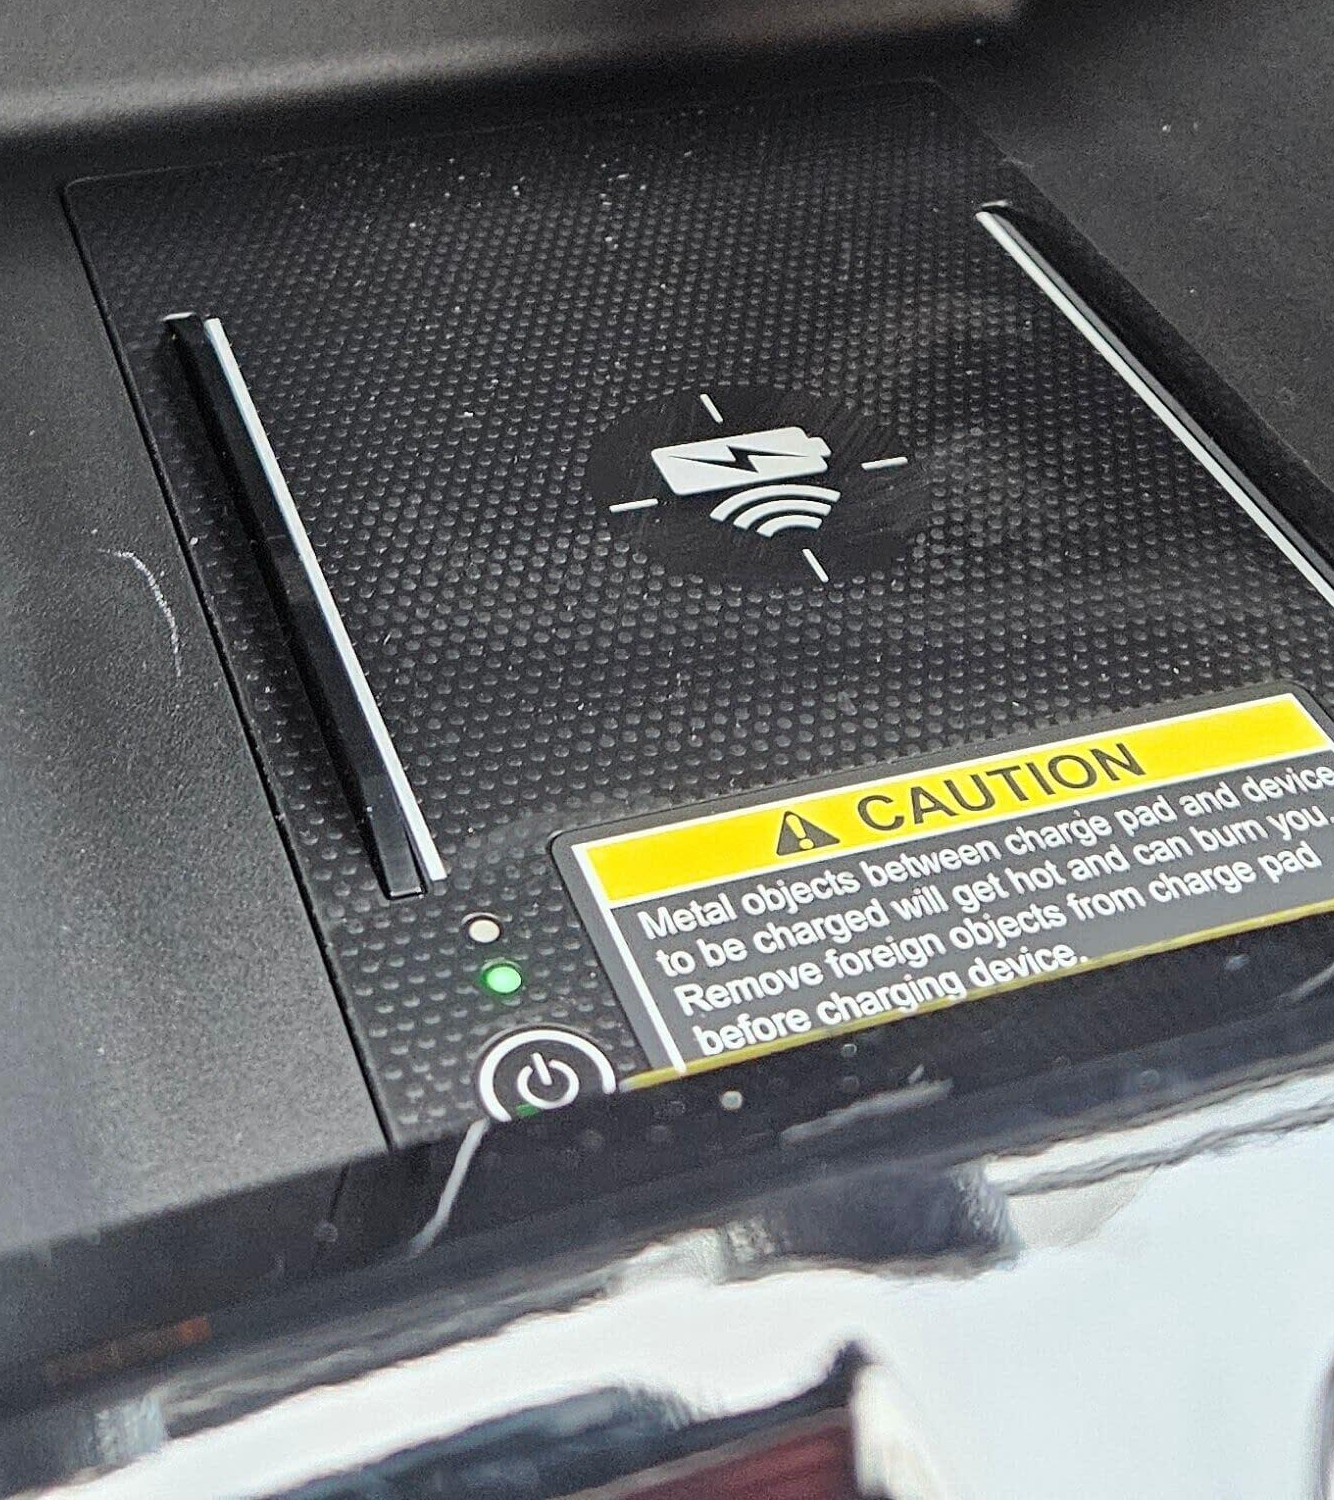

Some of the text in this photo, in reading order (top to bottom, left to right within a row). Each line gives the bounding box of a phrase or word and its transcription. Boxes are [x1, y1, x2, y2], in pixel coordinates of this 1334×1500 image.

[636, 892, 738, 940] Metal
[740, 869, 861, 915] objects
[858, 839, 1002, 888] between
[1004, 815, 1113, 856] charge
[1113, 794, 1178, 838] pad
[1178, 780, 1242, 817] and
[857, 742, 1146, 832] CAUTION
[654, 949, 696, 978] to
[695, 937, 748, 968] be
[752, 897, 891, 954] charged
[889, 884, 950, 921] will
[951, 872, 1010, 914] get
[1003, 859, 1068, 895] hot
[1066, 843, 1131, 882] and
[1132, 835, 1194, 866] can
[1188, 819, 1269, 853] burn
[672, 839, 1323, 1017] Remove foreign objects from charge pad
[691, 944, 1089, 1056] before charging device.
